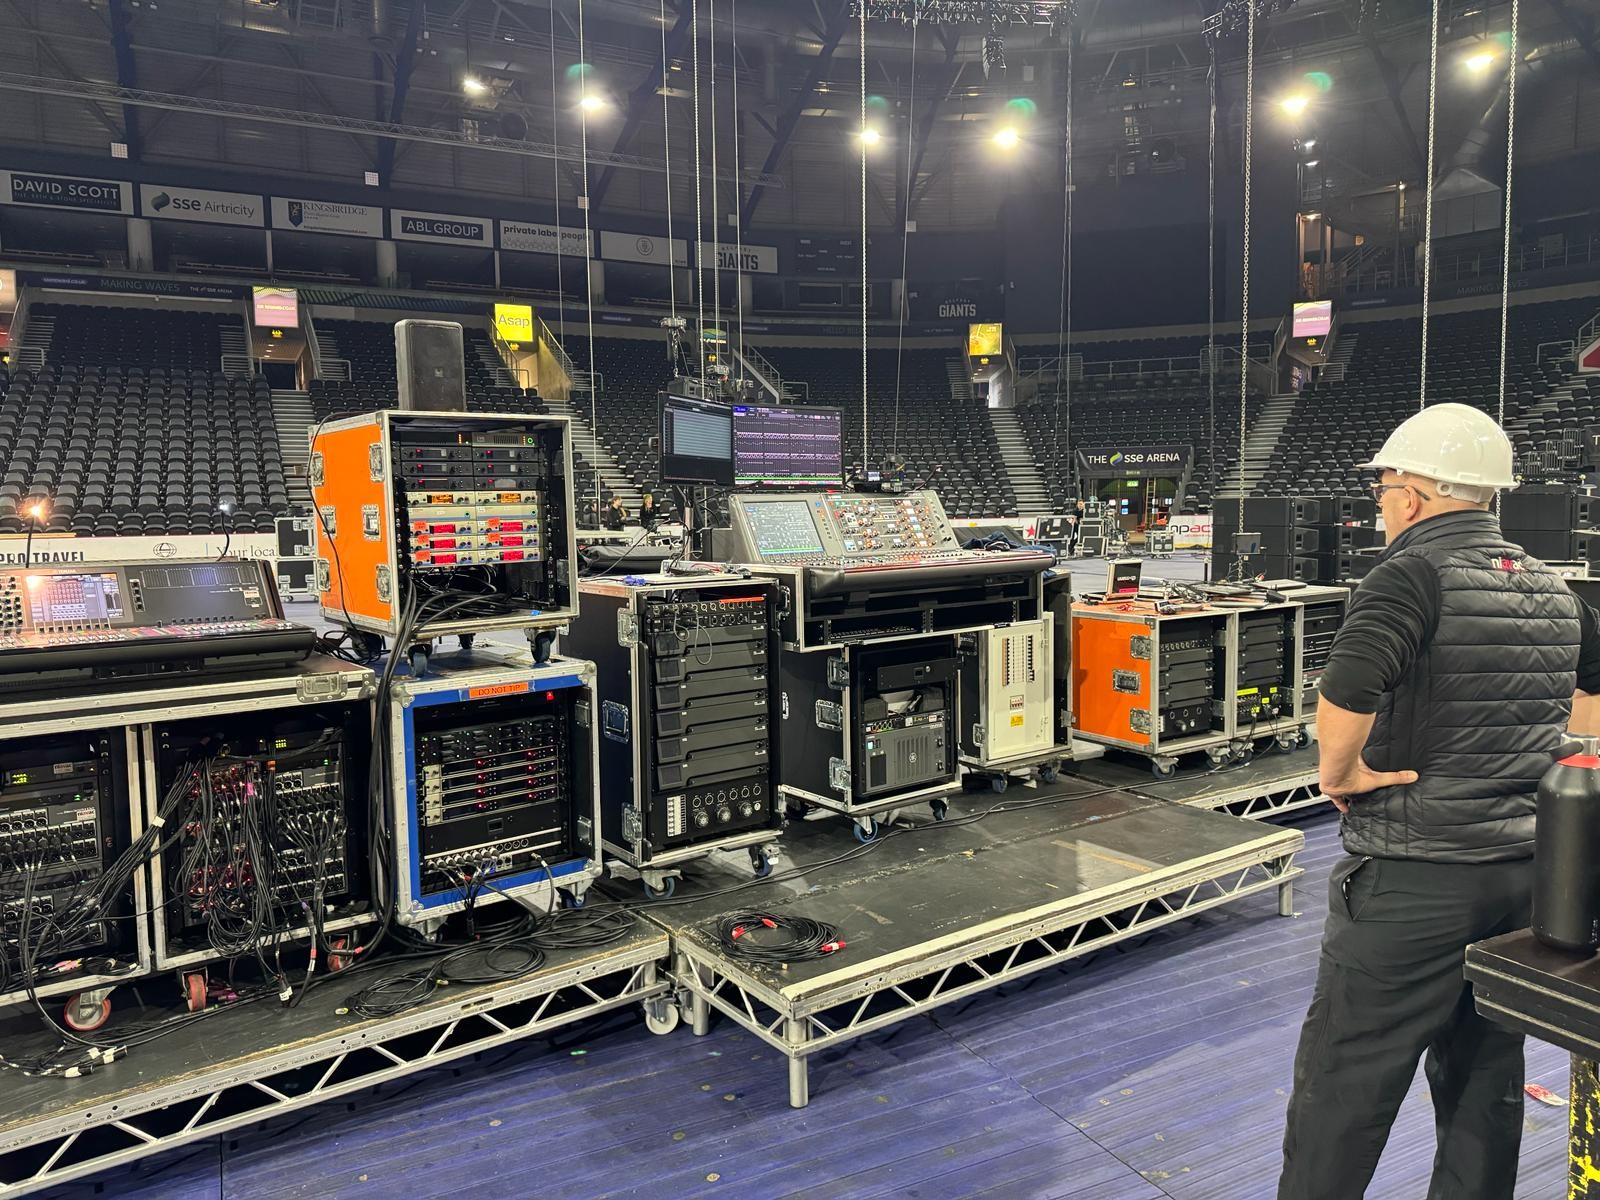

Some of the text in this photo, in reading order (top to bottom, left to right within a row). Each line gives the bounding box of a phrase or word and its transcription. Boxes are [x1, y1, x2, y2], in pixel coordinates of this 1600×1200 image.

[13, 179, 118, 199] DAVID SCOTT
[172, 198, 255, 218] sse Airtricity
[303, 202, 368, 216] KINGSBRIDGE
[406, 220, 479, 237] ABL GROUP
[503, 225, 590, 242] private labe peopl
[717, 252, 759, 270] GIANTS
[100, 279, 143, 290] MAKING
[144, 281, 180, 293] WAVES
[939, 303, 976, 318] GIANTS
[498, 313, 530, 328] Asap
[1087, 452, 1181, 464] THE sse ARENA
[478, 683, 521, 696] DO NOT TIP
